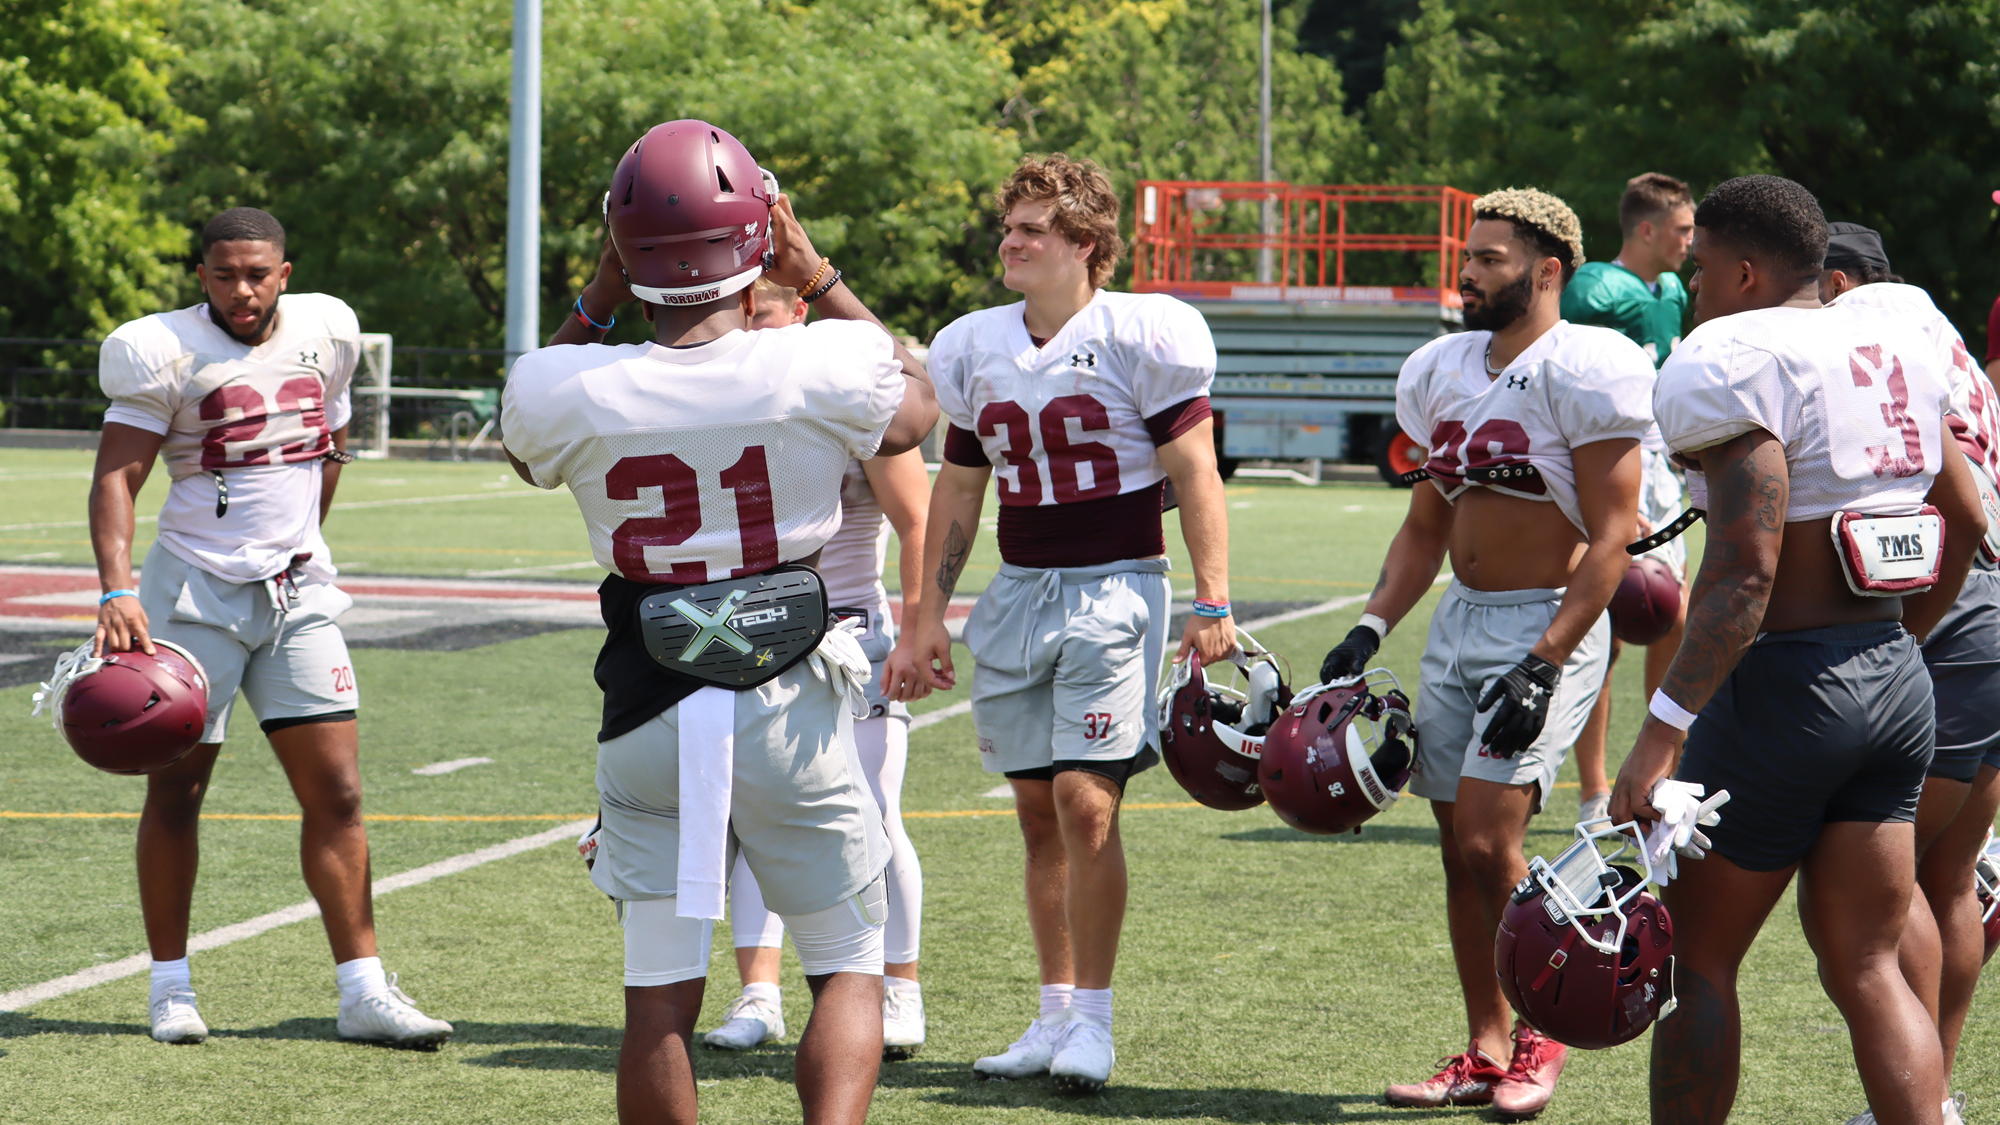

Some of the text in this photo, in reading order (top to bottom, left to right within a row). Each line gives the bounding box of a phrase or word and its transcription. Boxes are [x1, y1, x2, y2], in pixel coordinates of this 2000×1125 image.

[660, 287, 721, 304] FORDHAM
[1850, 343, 1925, 479] 3
[977, 394, 1121, 507] 36
[606, 445, 784, 585] 21
[1877, 533, 1924, 558] TMS
[331, 665, 353, 692] 20
[1083, 712, 1112, 739] 37
[1328, 781, 1345, 798] 26
